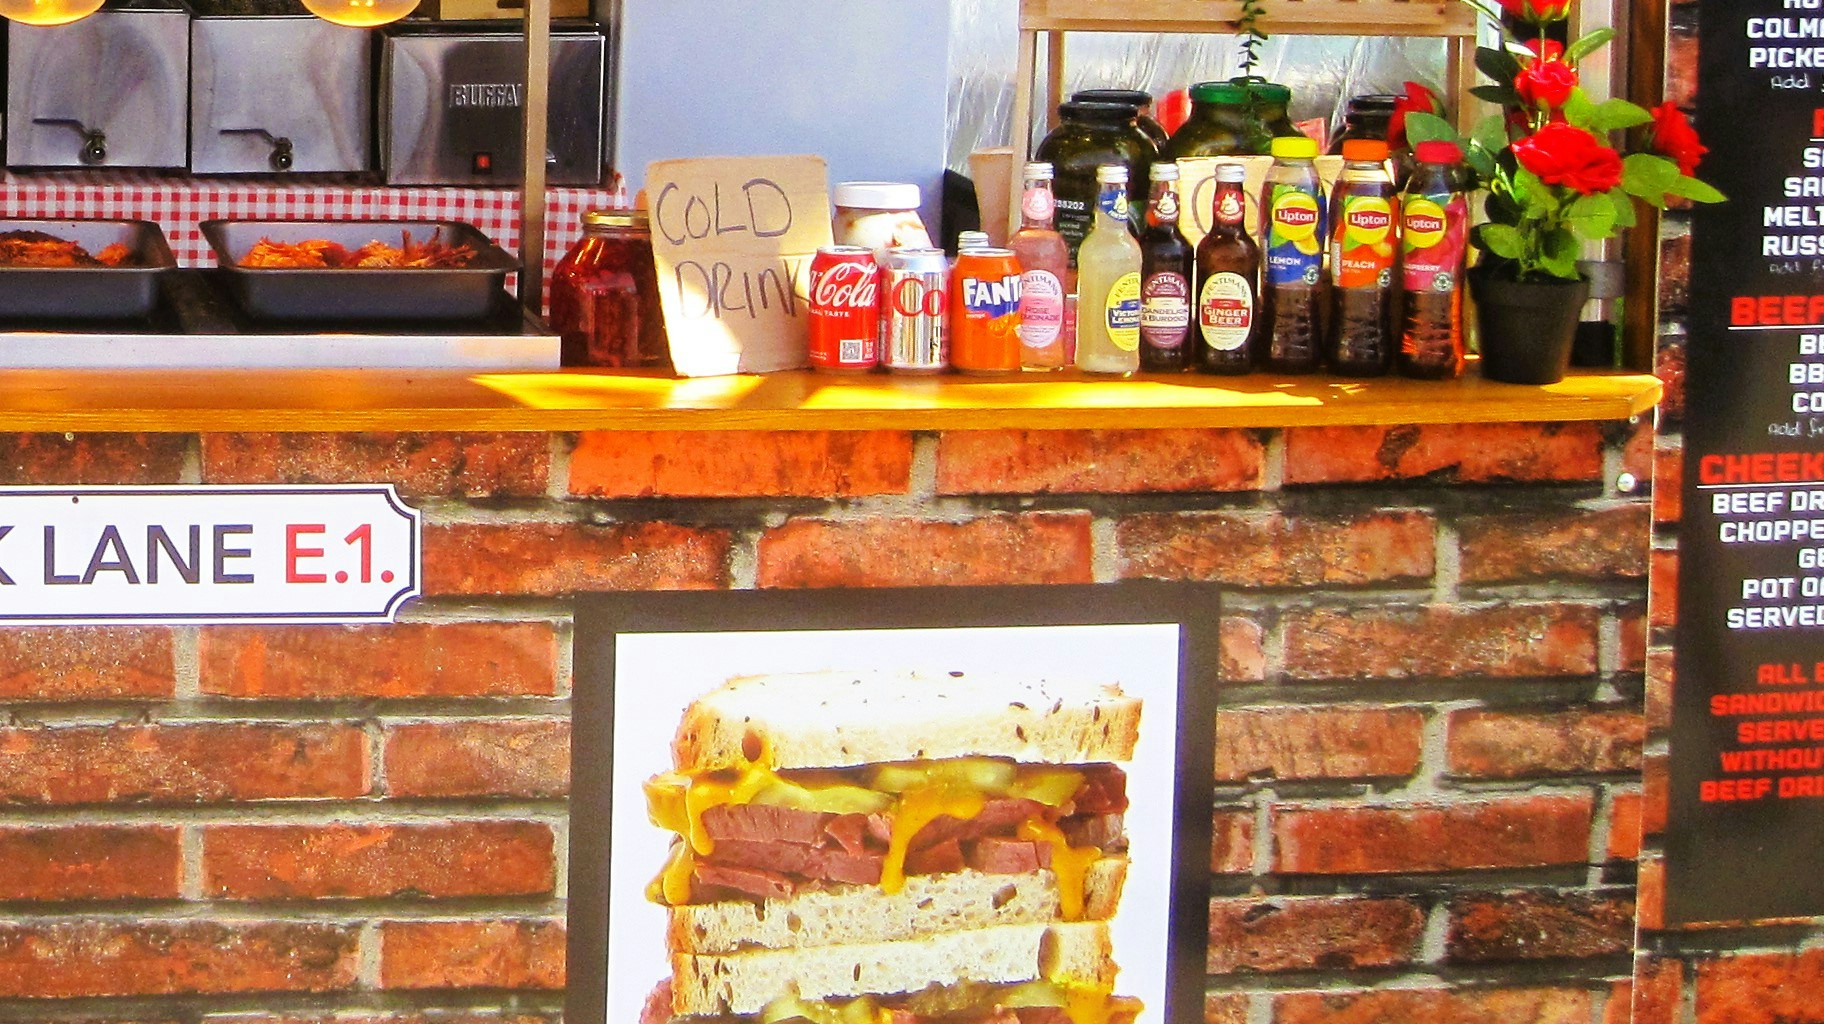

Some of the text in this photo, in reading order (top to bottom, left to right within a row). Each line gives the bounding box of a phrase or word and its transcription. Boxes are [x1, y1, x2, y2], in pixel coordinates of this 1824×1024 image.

[1770, 73, 1811, 89] Add
[656, 177, 793, 246] COLD
[1278, 210, 1313, 223] Lipton
[1351, 214, 1388, 226] Lipton
[1406, 218, 1440, 230] Lipton
[1269, 257, 1301, 266] LEMON
[1341, 260, 1375, 269] PEACH
[962, 274, 1023, 307] FANT
[1204, 308, 1248, 317] GINGER
[1209, 316, 1242, 325] BEER
[1712, 492, 1784, 514] BEEF
[43, 523, 254, 585] LANE
[285, 523, 394, 584] E.1.
[1742, 578, 1795, 600] POT
[1757, 664, 1807, 685] ALL
[1699, 779, 1773, 802] BEEF
